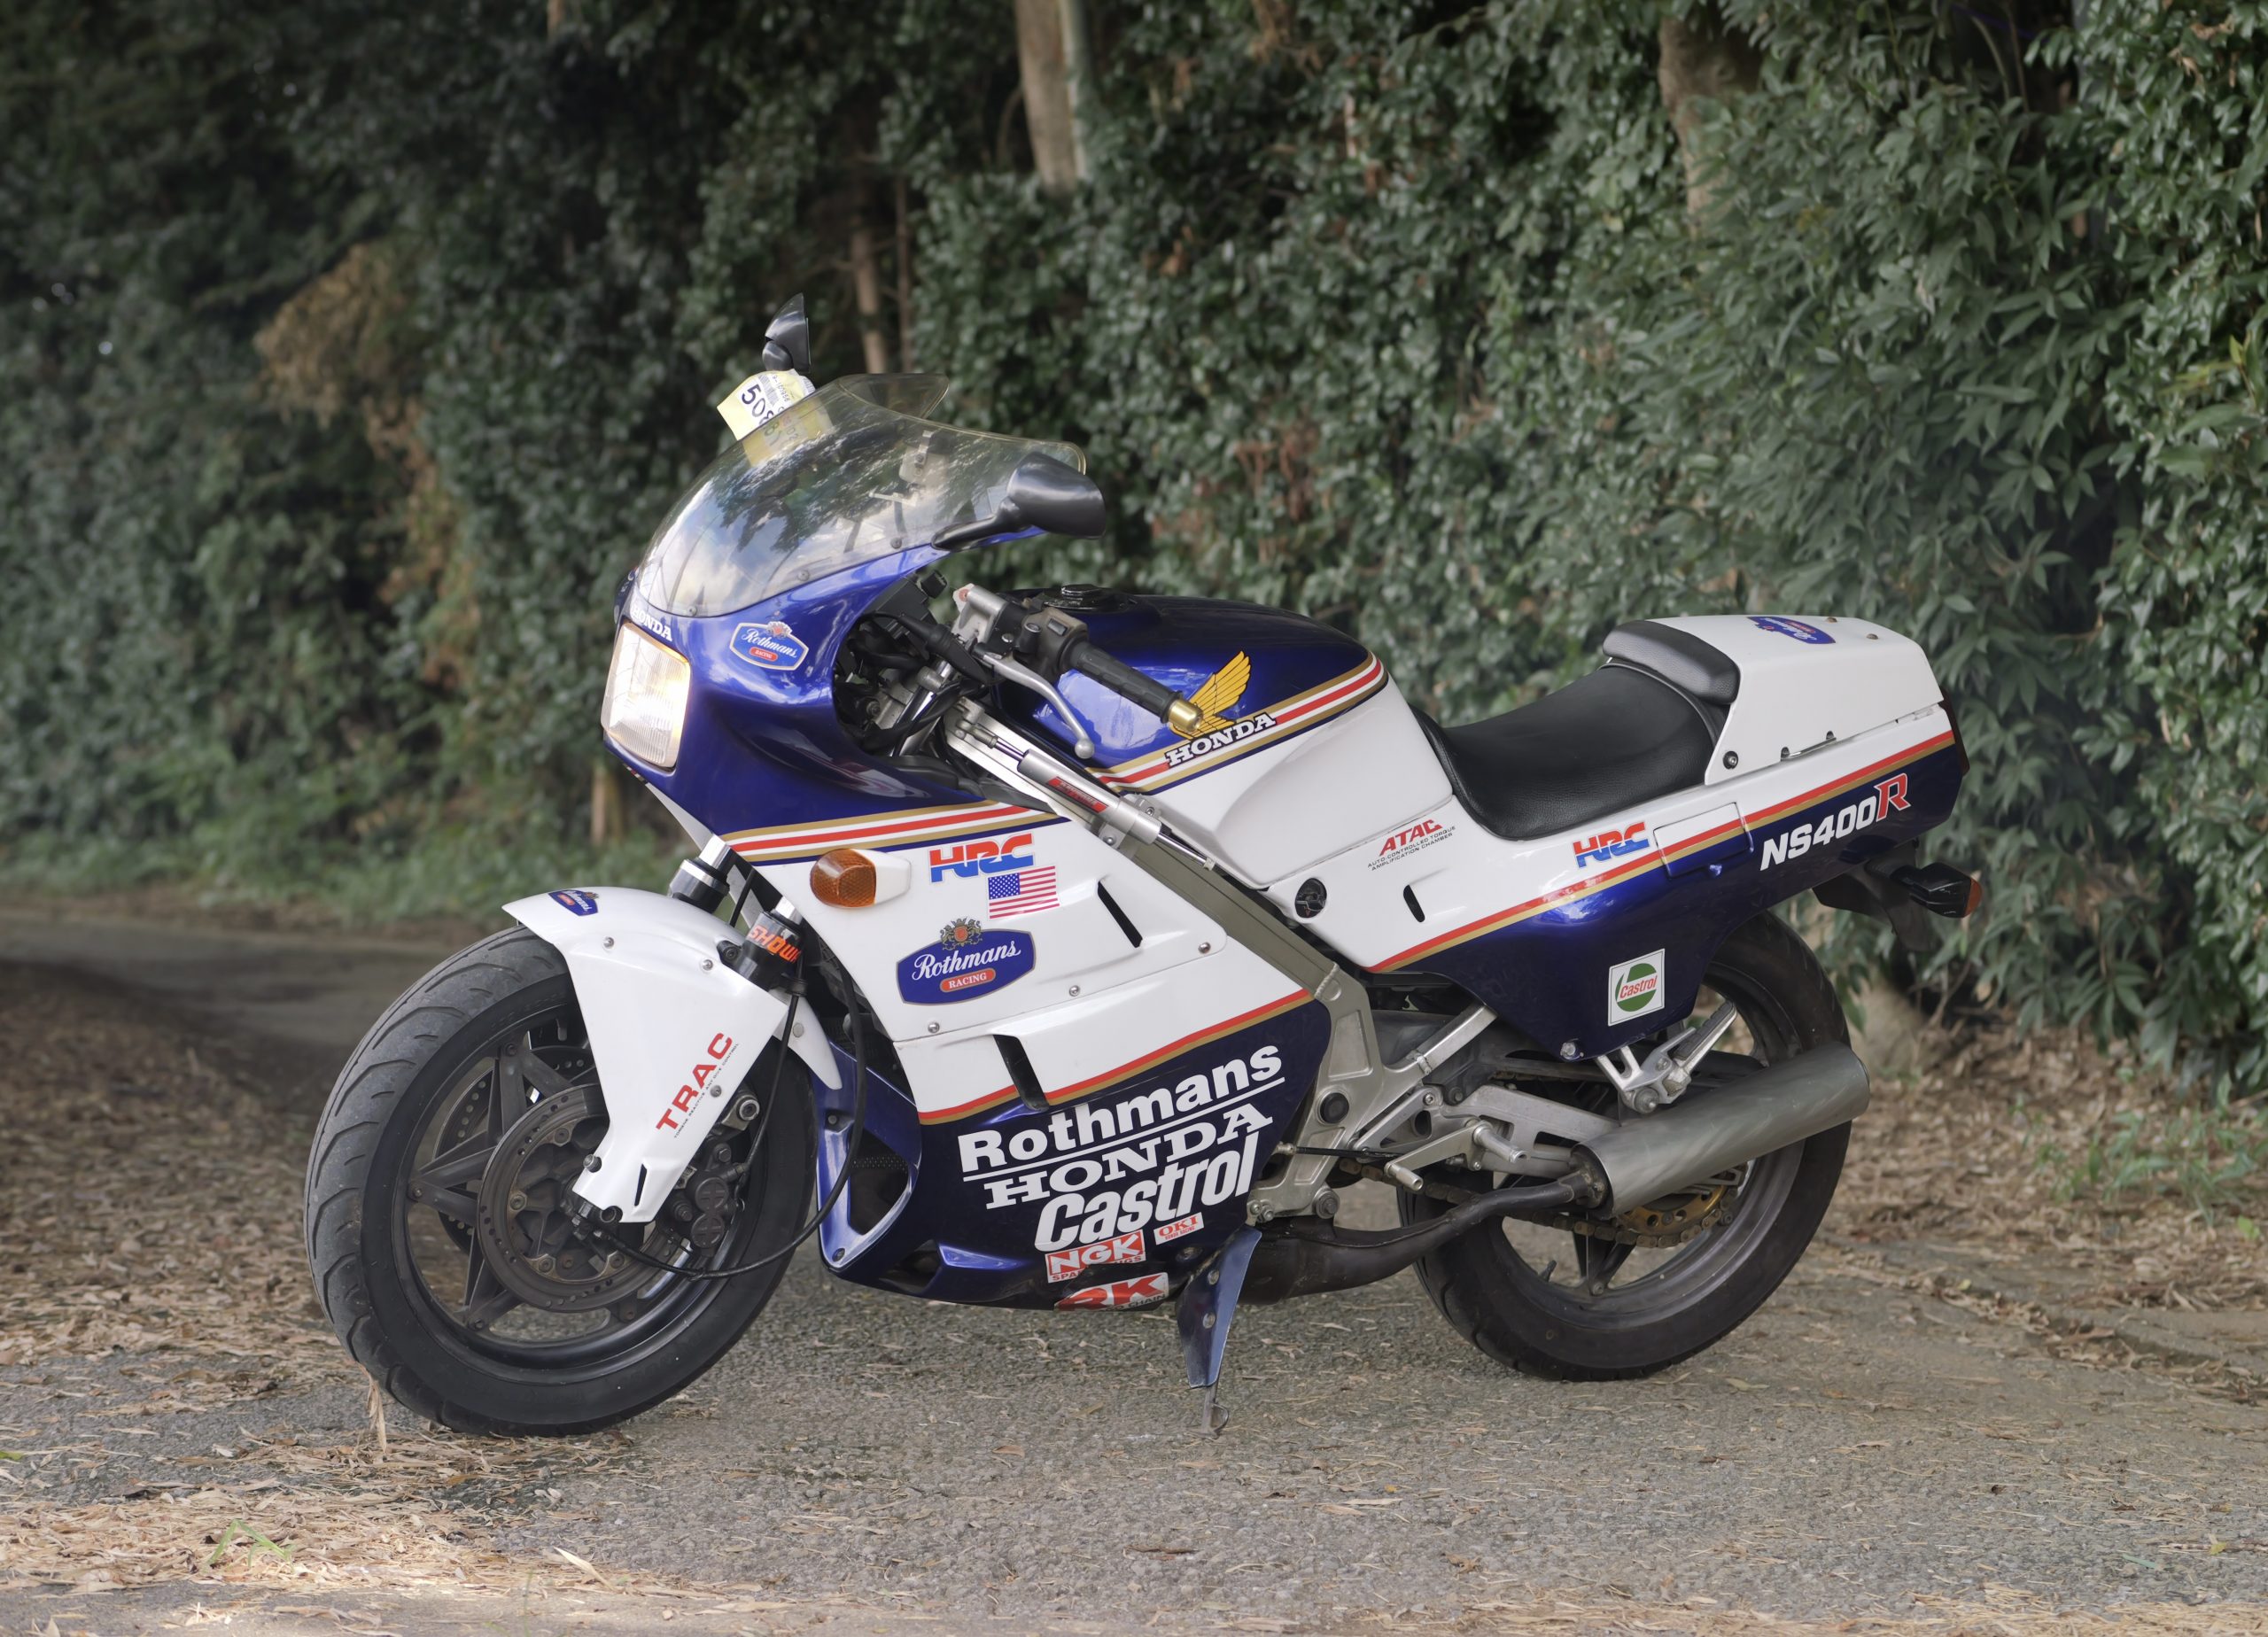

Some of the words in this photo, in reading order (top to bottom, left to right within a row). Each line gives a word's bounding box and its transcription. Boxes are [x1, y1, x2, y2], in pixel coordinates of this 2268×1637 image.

[741, 628, 797, 658] Rothmans
[1166, 713, 1276, 766] HONDA
[1379, 818, 1443, 857] ATAC
[1430, 826, 1456, 840] TORQUE
[1759, 773, 1911, 871] NS400R
[928, 833, 1035, 883] HRC
[1371, 848, 1420, 871] AMPLIFICATION
[1421, 833, 1453, 849] CHAMBER
[1573, 822, 1650, 869] HRC
[912, 940, 1021, 981] Rothmans
[948, 973, 987, 989] RACING
[1620, 975, 1658, 999] Castrol
[656, 1032, 733, 1132] TRAC
[958, 1045, 1282, 1173] Rothmans
[983, 1103, 1273, 1210] HONDA
[1035, 1131, 1259, 1252] Castrol
[1159, 1215, 1198, 1237] OKI
[1050, 1233, 1141, 1274] NGK
[1052, 1270, 1082, 1281] SPA
[1058, 1275, 1166, 1311] RK
[1128, 1293, 1166, 1308] CHAIN
